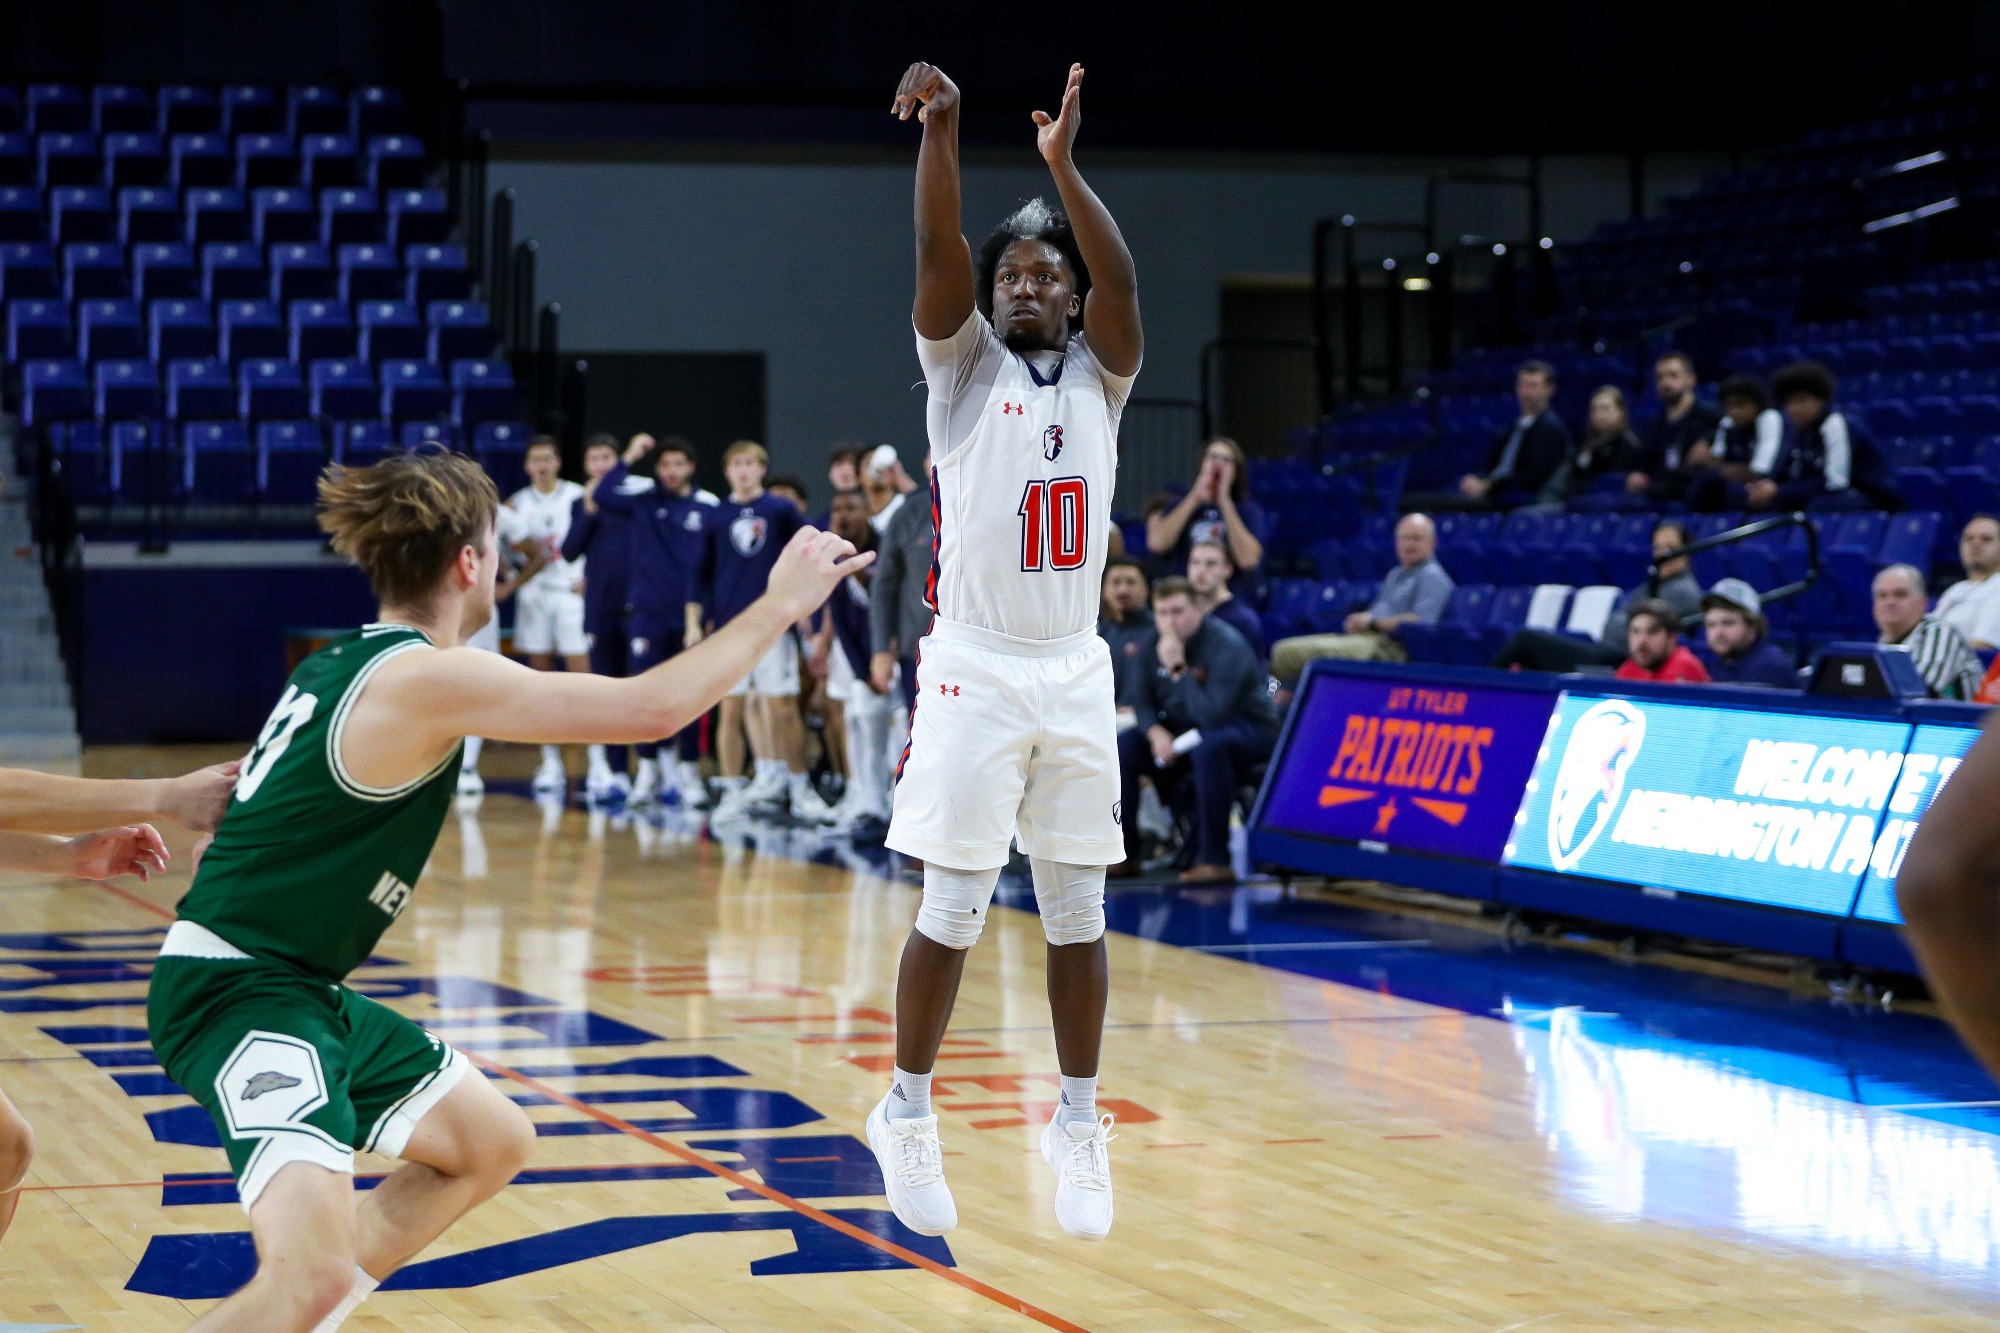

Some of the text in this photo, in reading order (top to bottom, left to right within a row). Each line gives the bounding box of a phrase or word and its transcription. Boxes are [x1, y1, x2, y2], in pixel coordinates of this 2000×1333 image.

[1017, 475, 1088, 573] 10
[1414, 688, 1468, 716] TYLER
[1328, 714, 1495, 796] PATRIOTS
[1734, 738, 1938, 813] WELCOME
